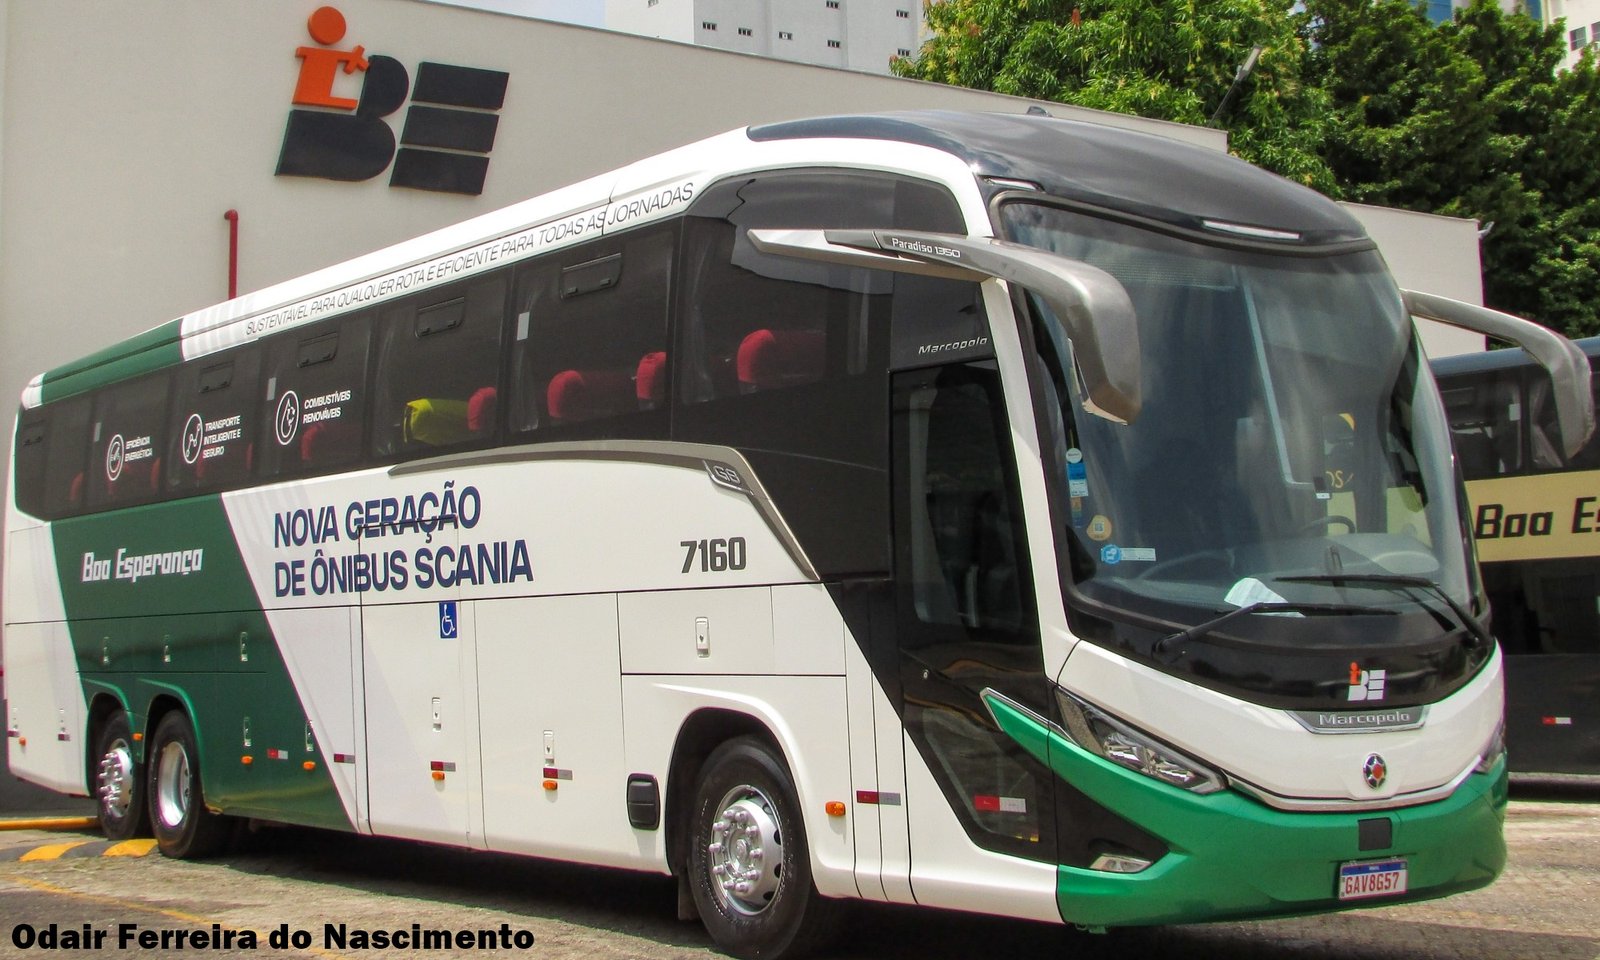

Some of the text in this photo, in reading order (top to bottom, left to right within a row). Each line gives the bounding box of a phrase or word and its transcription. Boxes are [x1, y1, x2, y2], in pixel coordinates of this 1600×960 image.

[892, 237, 961, 258] Paradiso 1350
[246, 182, 694, 335] SUSTENTÁVEL PARA QUALQUER ROTA E EFICIENTE PARA TODAS AS JORNADAS
[918, 336, 988, 355] Marcopolo
[304, 390, 351, 409] COMBUSTÍVEIS
[205, 415, 240, 432] TRANSPORTE
[303, 407, 341, 424] RENOVÁVEIS
[203, 430, 236, 446] INTELIGENTE
[203, 447, 224, 459] SEGURO
[274, 480, 481, 548] NOVA GERAÇÃO
[1475, 504, 1553, 539] Boa
[680, 536, 746, 573] 7160
[82, 548, 204, 583] Boa Esperança
[275, 539, 534, 597] DE ÔNIBUS SCANIA
[1319, 711, 1410, 726] Marcopolo
[1345, 872, 1400, 894] GAV8G57
